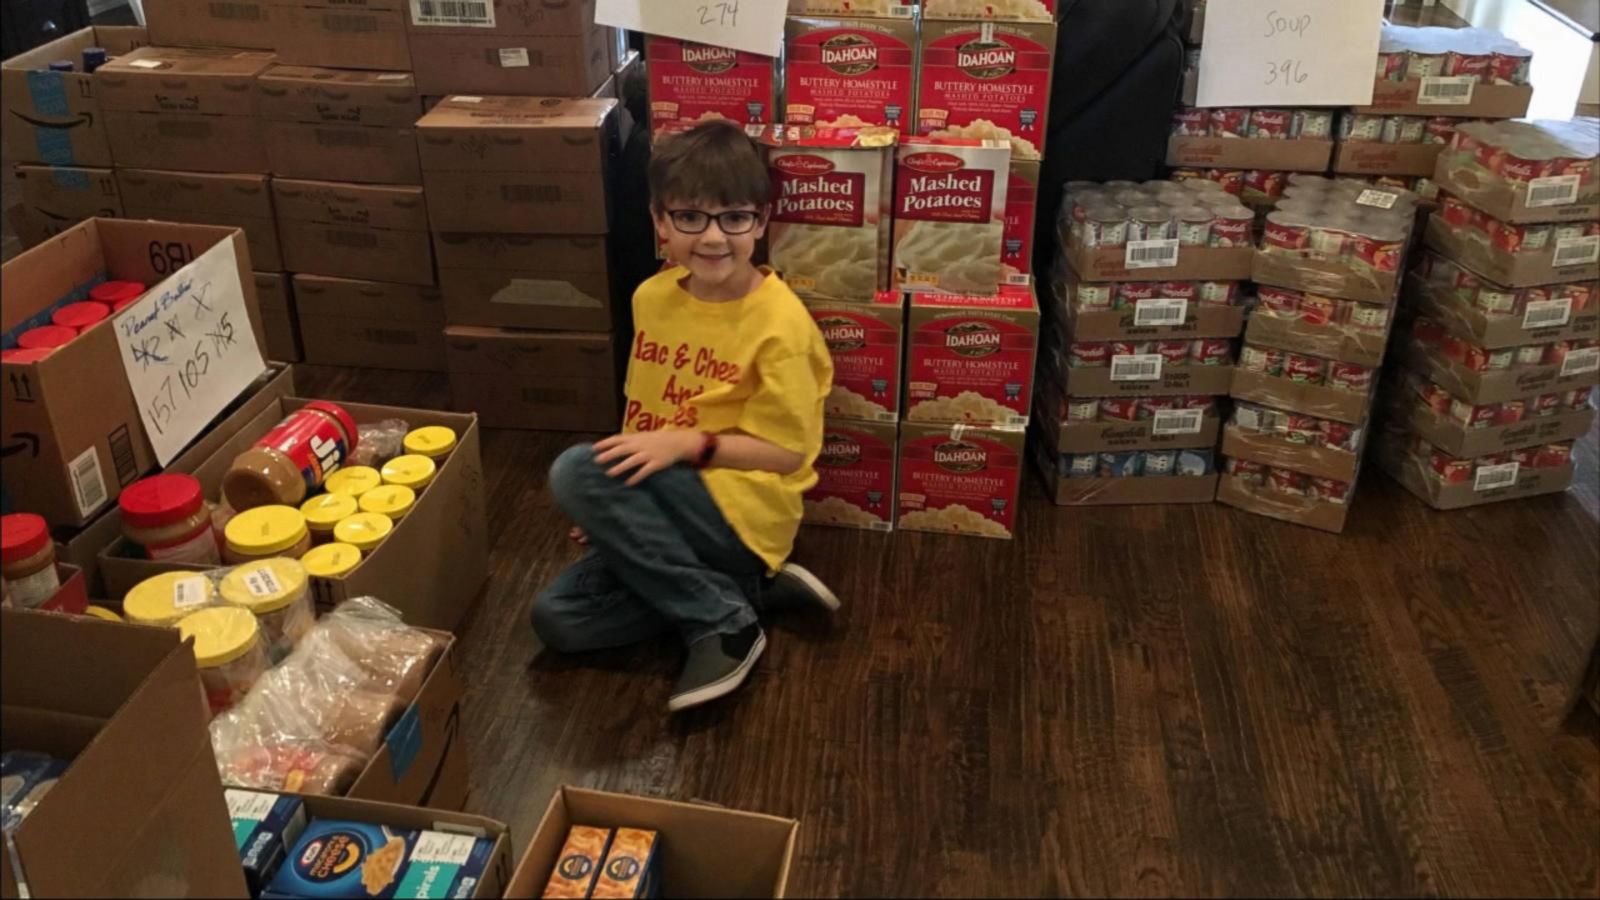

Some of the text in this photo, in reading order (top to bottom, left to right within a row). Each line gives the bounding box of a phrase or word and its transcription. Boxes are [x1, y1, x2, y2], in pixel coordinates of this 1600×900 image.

[682, 47, 736, 62] IDAHOAN
[822, 47, 878, 63] IDAHOAN
[957, 51, 1015, 67] IDAHOAN
[1264, 59, 1309, 85] 396
[662, 75, 760, 88] BUTTERY HOMESTYLE
[800, 77, 898, 90] BUTTERY HOMESTYLE
[934, 81, 1035, 95] BUTTERY HOMESTYLE
[782, 176, 853, 197] Mashed
[910, 173, 982, 195] Mashed
[776, 196, 855, 215] Potatoes
[903, 193, 983, 213] Potatoes
[823, 327, 865, 340] AHOAN
[945, 333, 1001, 347] IDAHOAN
[672, 343, 692, 370] &
[694, 346, 740, 385] Chee
[923, 358, 1020, 371] BUTTERY HOMESTYLE
[148, 374, 177, 435] 157
[178, 340, 209, 401] 105
[822, 444, 861, 455] AHOAN
[934, 451, 987, 463] IDAHOAN
[912, 471, 1004, 487] BUTTERY HOMESTYLE
[415, 865, 441, 898] pirals
